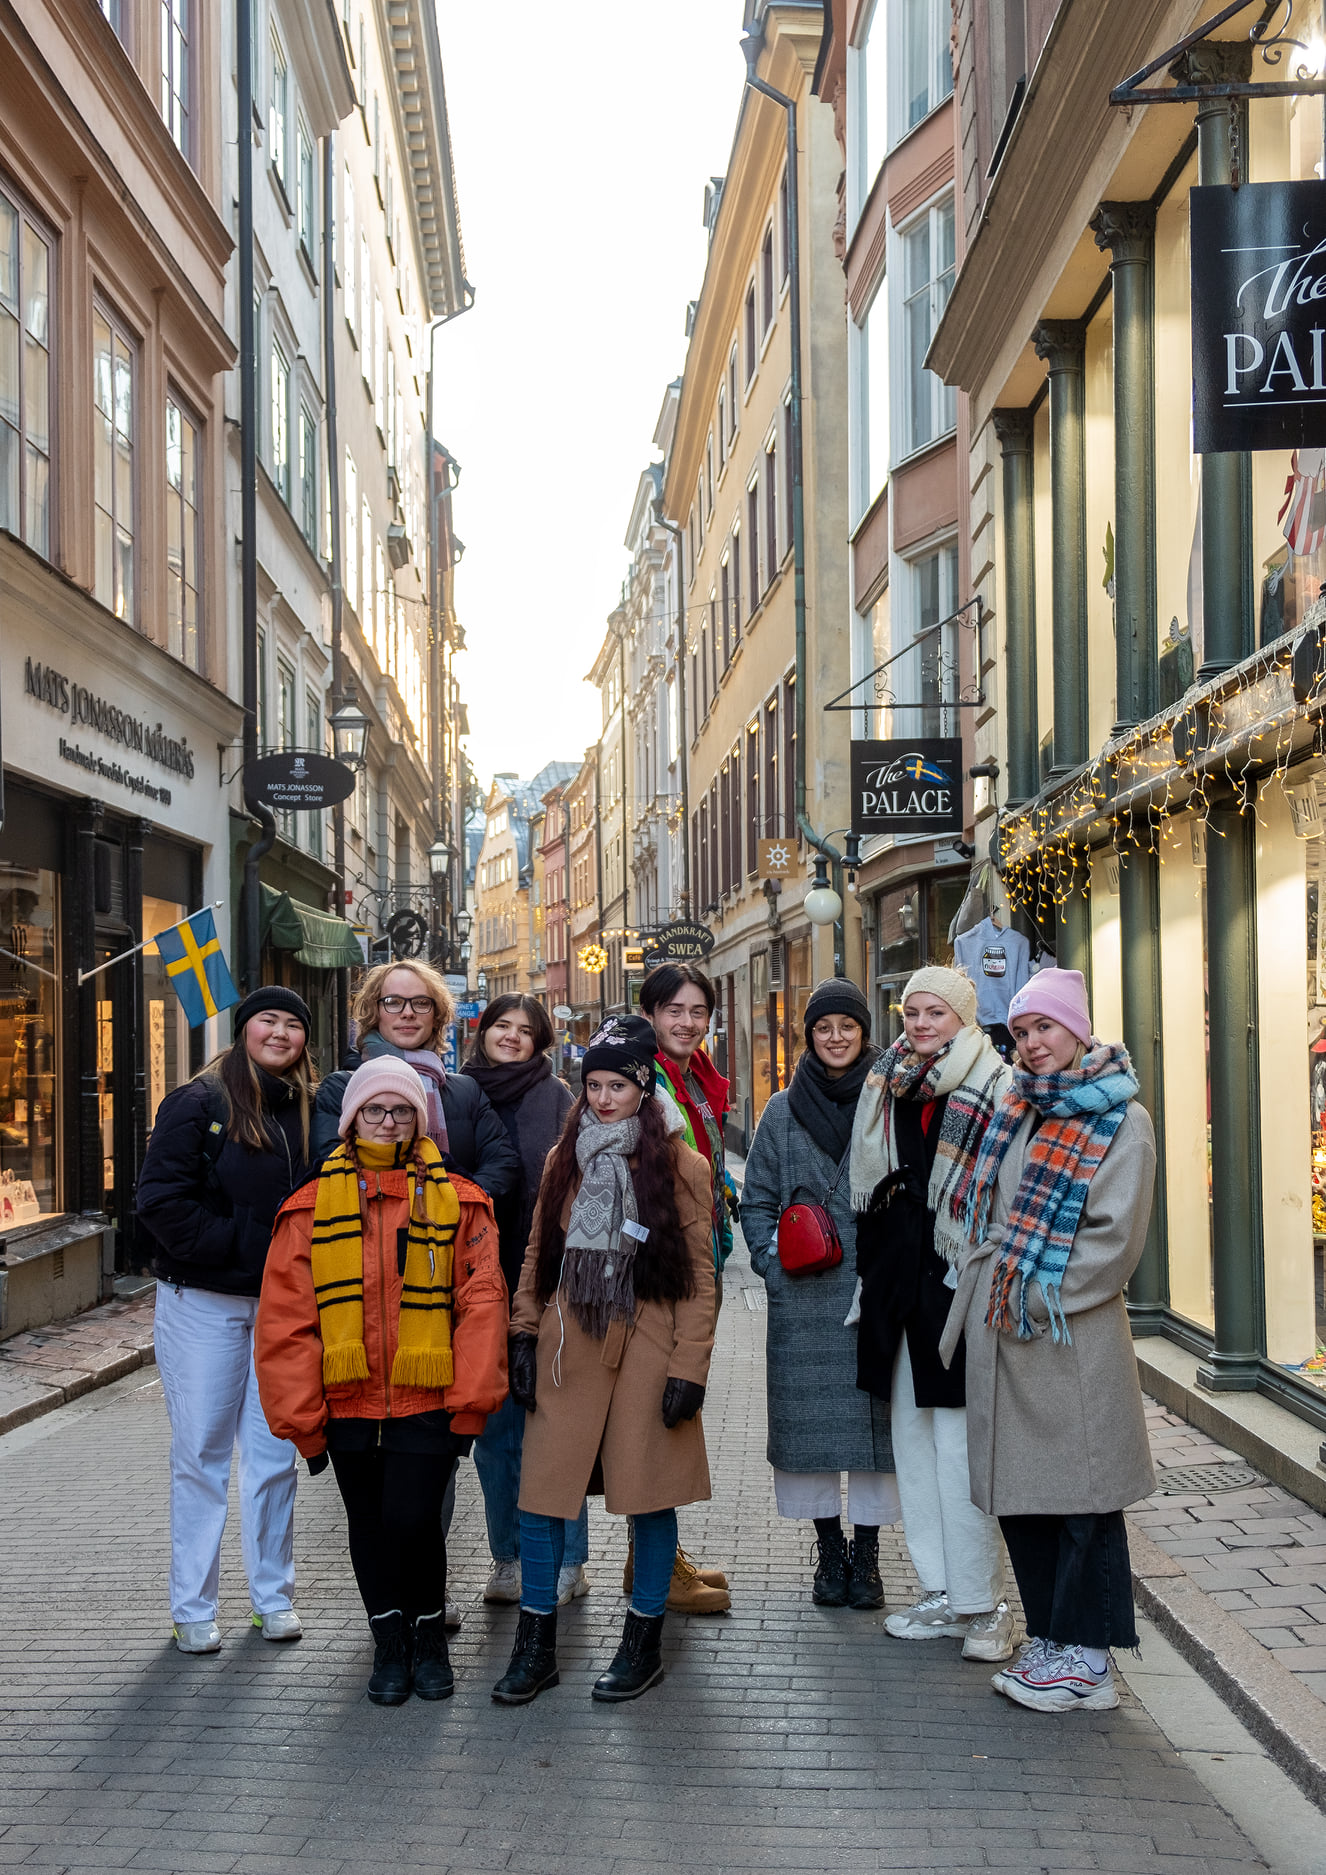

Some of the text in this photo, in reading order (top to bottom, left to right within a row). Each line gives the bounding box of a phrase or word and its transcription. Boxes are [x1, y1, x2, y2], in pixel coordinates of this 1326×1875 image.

[25, 656, 69, 713] MATS
[71, 683, 143, 755] JONASSON
[59, 737, 96, 773] Handmade
[98, 757, 123, 784] Swedish
[866, 753, 924, 788] The
[273, 793, 301, 802] Concept
[287, 784, 324, 792] JONASSON
[861, 790, 952, 815] PALACE
[659, 926, 712, 943] HANDKRAFT
[668, 943, 703, 955] SWEA
